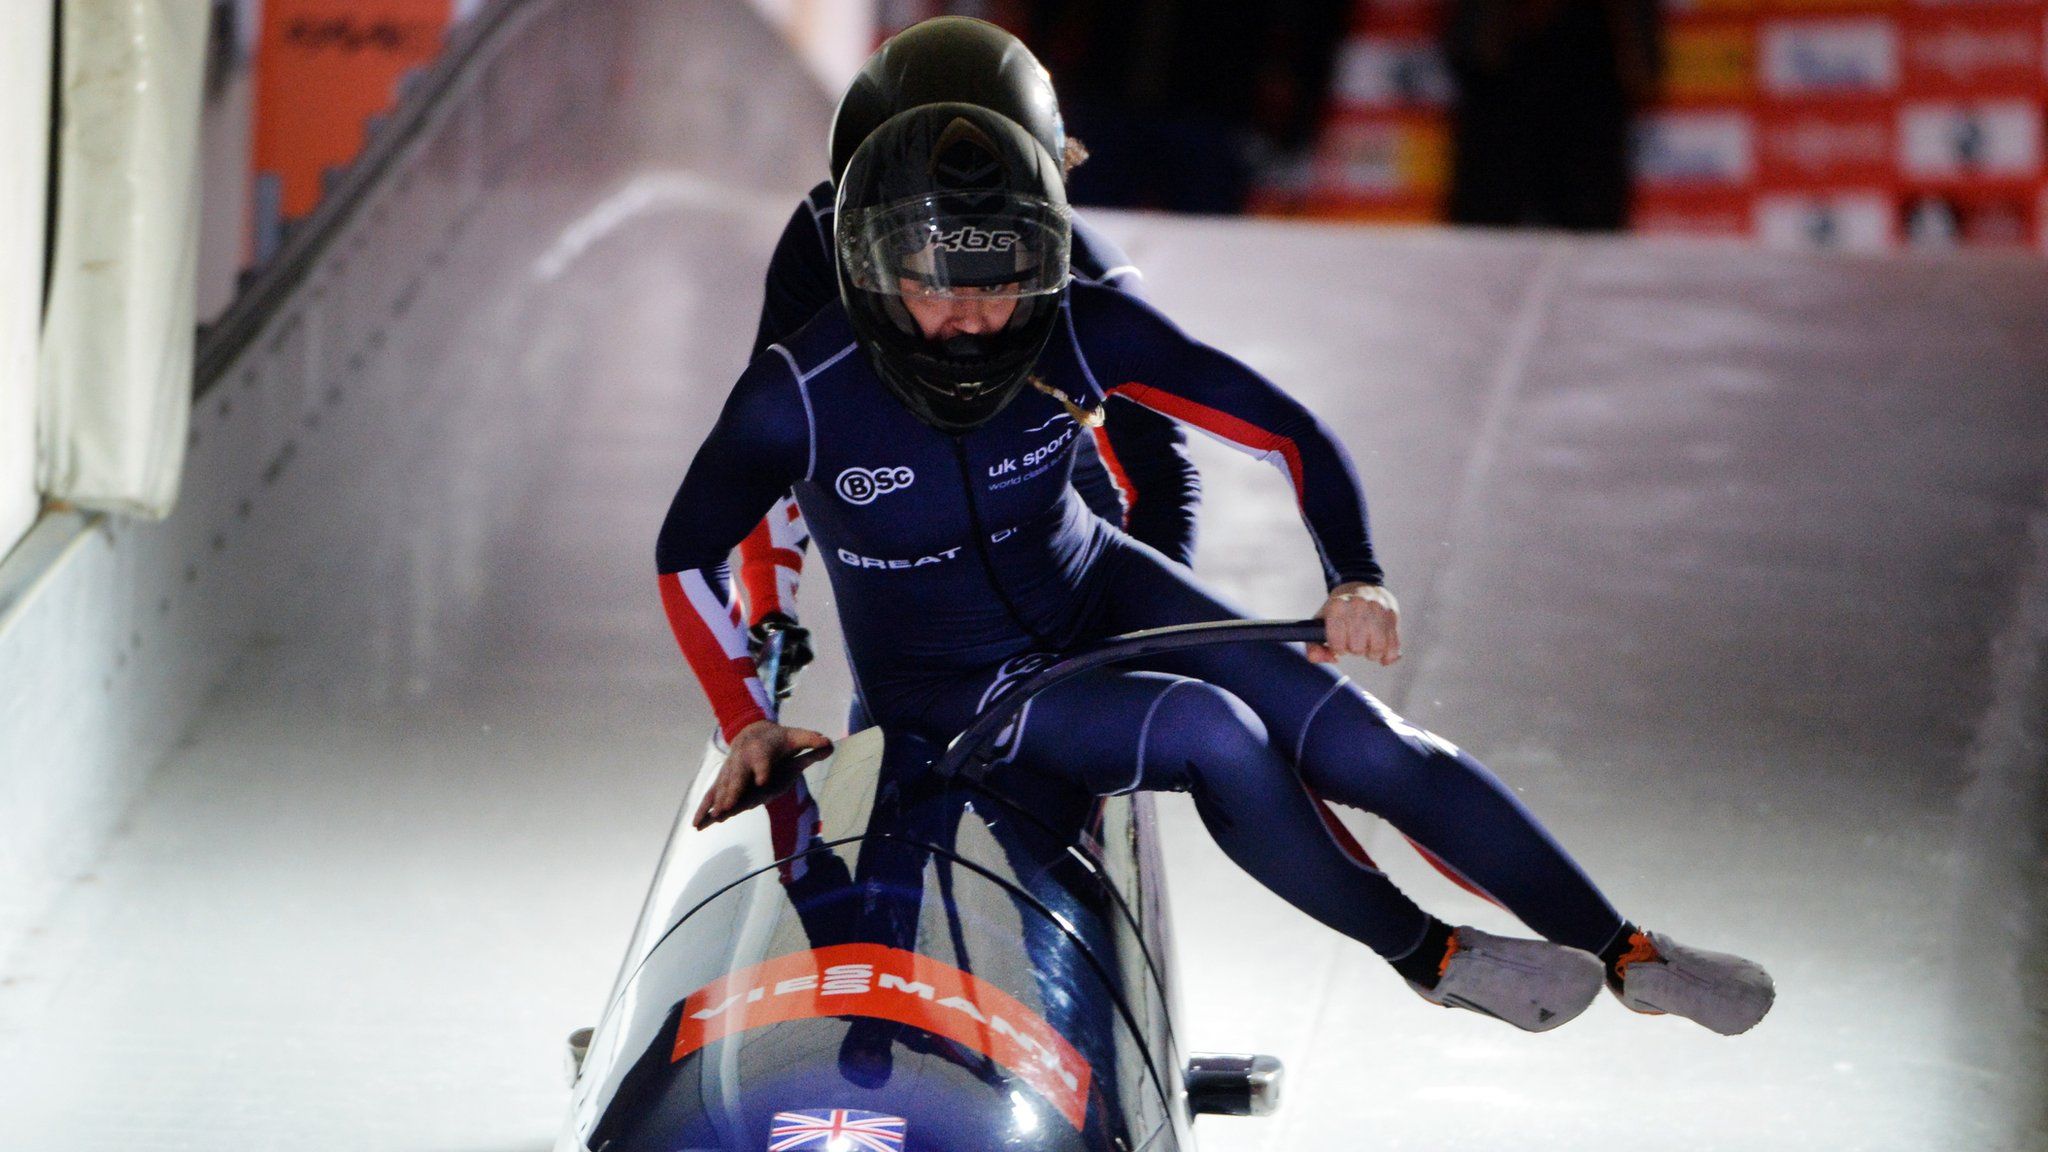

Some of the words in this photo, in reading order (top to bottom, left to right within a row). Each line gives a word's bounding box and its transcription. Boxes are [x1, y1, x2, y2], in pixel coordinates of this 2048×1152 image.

[988, 458, 1017, 477] uk
[1023, 428, 1072, 466] sport
[988, 475, 1021, 491] world
[838, 547, 962, 569] GREAT
